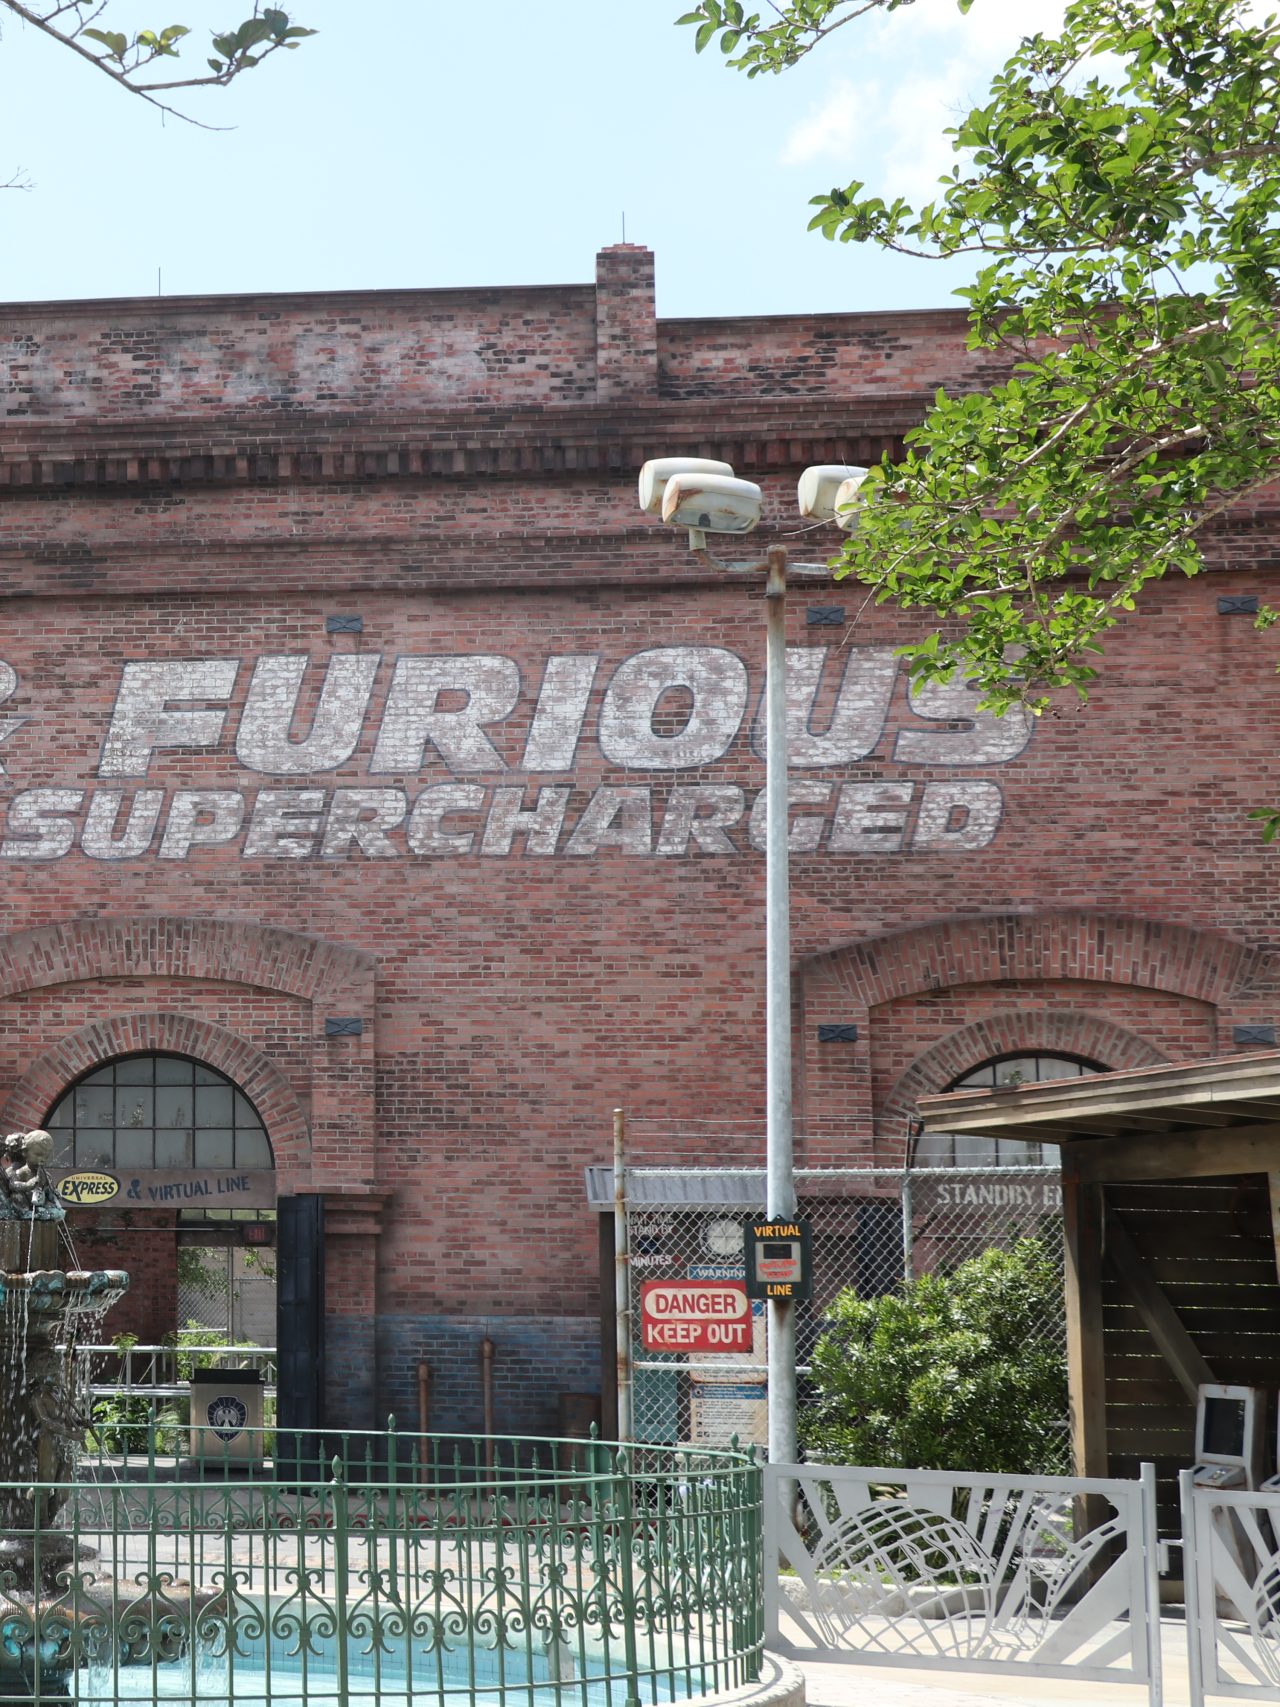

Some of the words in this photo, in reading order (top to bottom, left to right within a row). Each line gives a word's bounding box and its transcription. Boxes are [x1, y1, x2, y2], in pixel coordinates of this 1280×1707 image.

[97, 645, 1036, 778] FURIOUS
[61, 1180, 116, 1202] EXPRESS
[127, 1178, 142, 1200] &
[147, 1179, 213, 1202] VIRTUAL
[217, 1175, 251, 1194] LINE
[937, 1183, 1036, 1206] STANDBY
[753, 1225, 801, 1237] VIRTUAL
[628, 1255, 671, 1267] MINUTES
[767, 1284, 793, 1296] LINE
[655, 1294, 737, 1314] DANGER
[647, 1324, 702, 1343] KEEP
[707, 1324, 747, 1344] OUT
